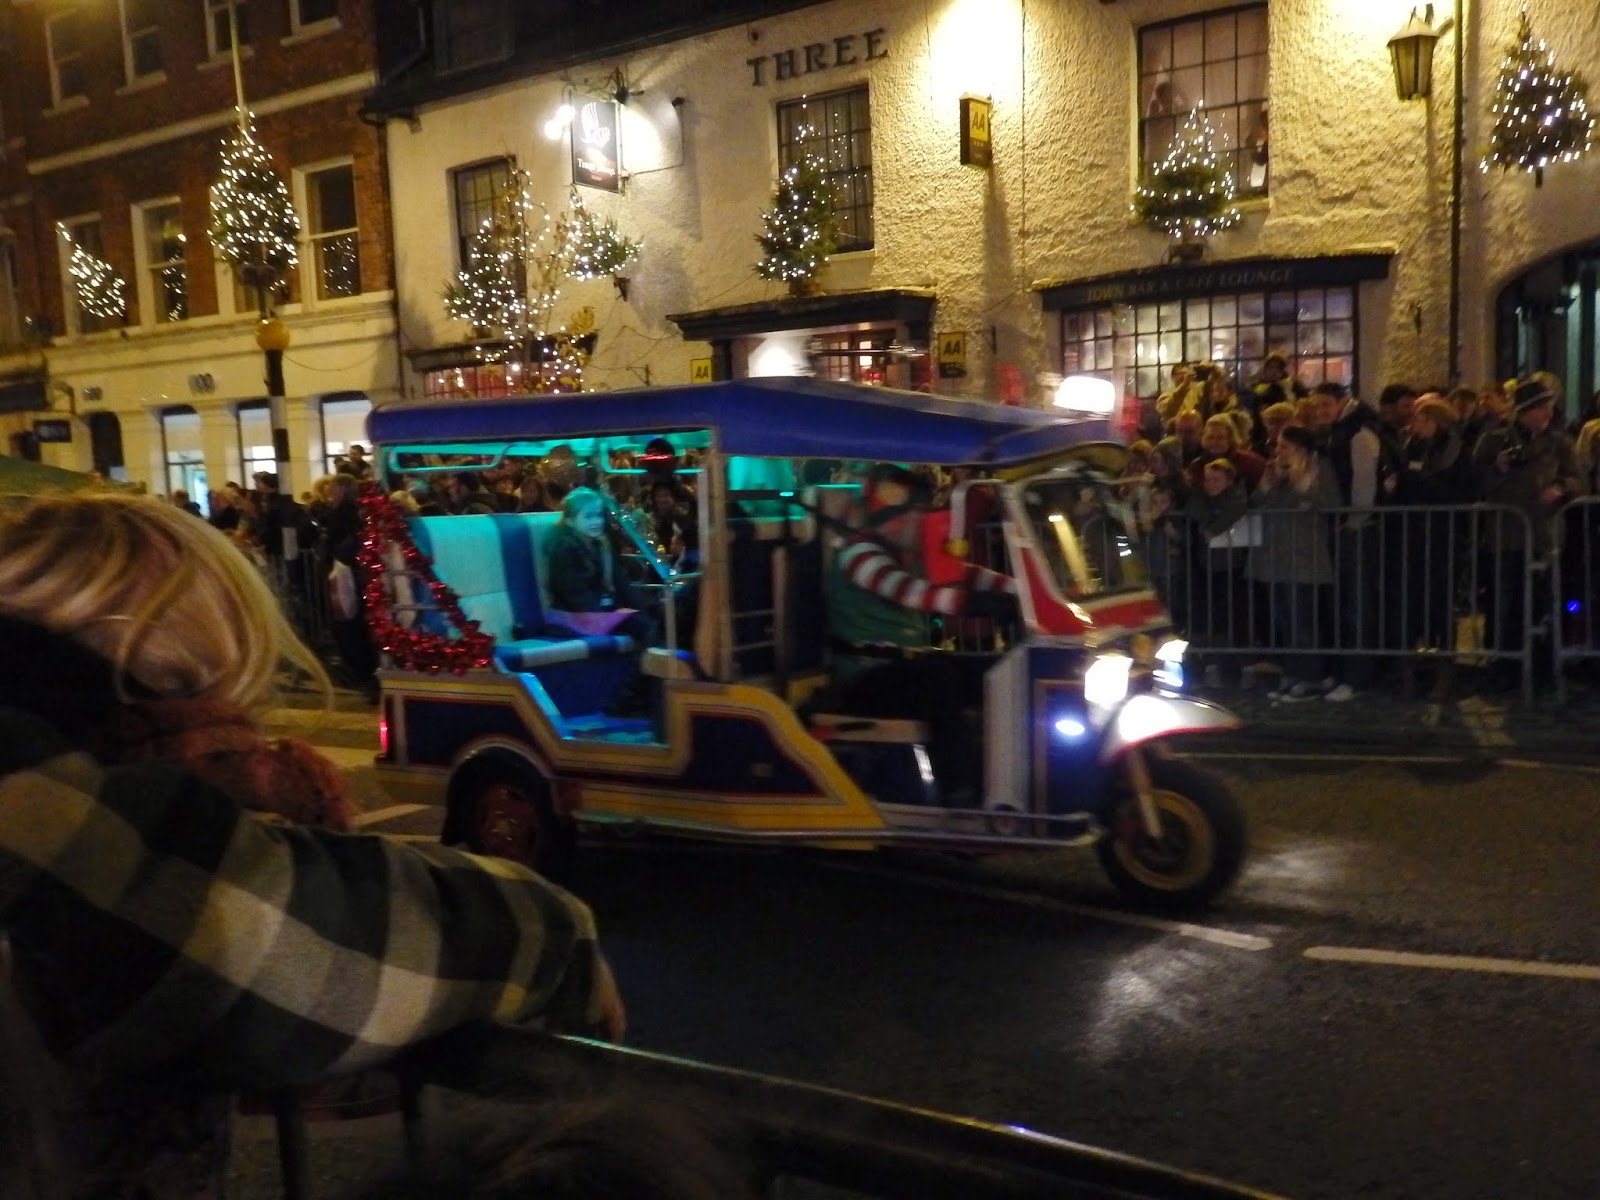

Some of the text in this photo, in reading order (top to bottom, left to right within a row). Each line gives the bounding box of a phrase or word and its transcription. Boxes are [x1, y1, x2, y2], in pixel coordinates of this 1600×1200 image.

[746, 27, 889, 87] THREE
[971, 110, 986, 132] AA
[1218, 267, 1295, 287] LOUNGE
[943, 340, 961, 356] AA
[695, 365, 709, 379] AA
